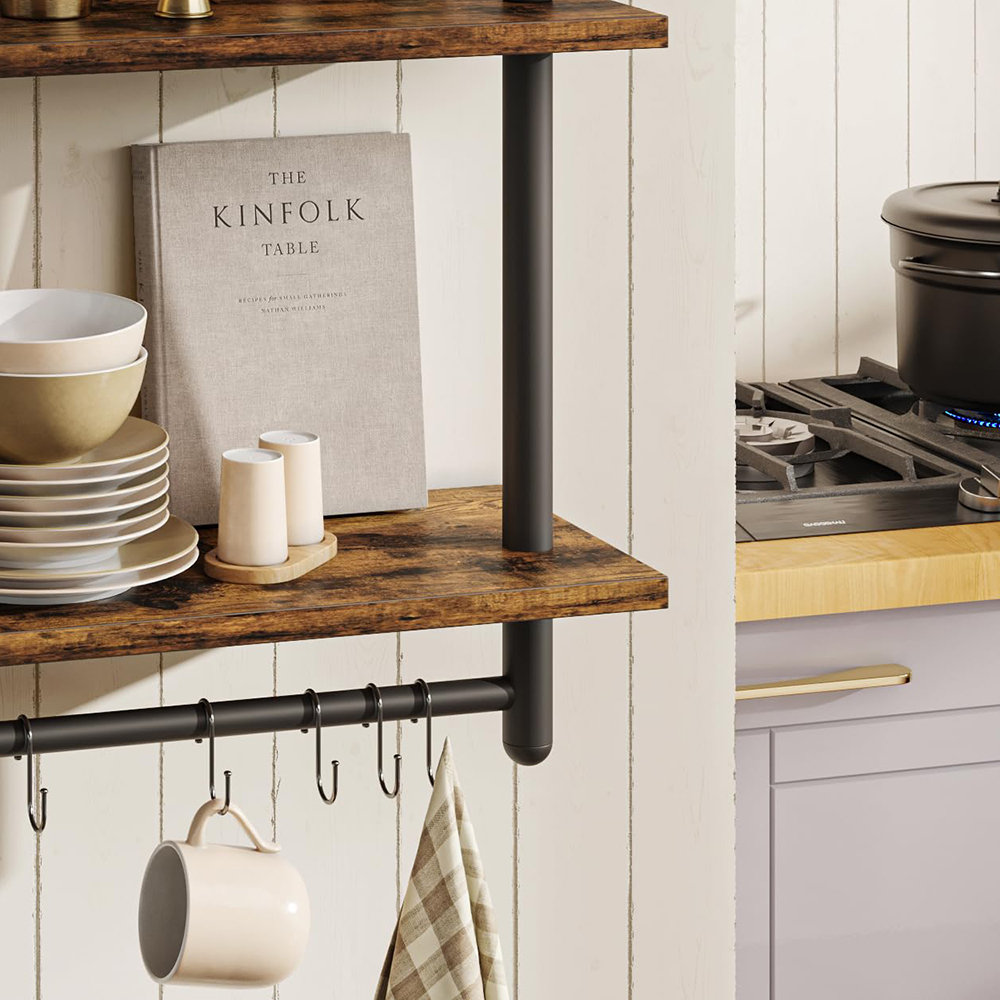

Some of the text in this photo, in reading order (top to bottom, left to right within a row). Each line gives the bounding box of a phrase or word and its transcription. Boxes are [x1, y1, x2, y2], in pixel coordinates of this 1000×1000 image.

[268, 170, 307, 185] THE
[213, 197, 365, 228] KINFOLK
[261, 240, 320, 256] TABLE
